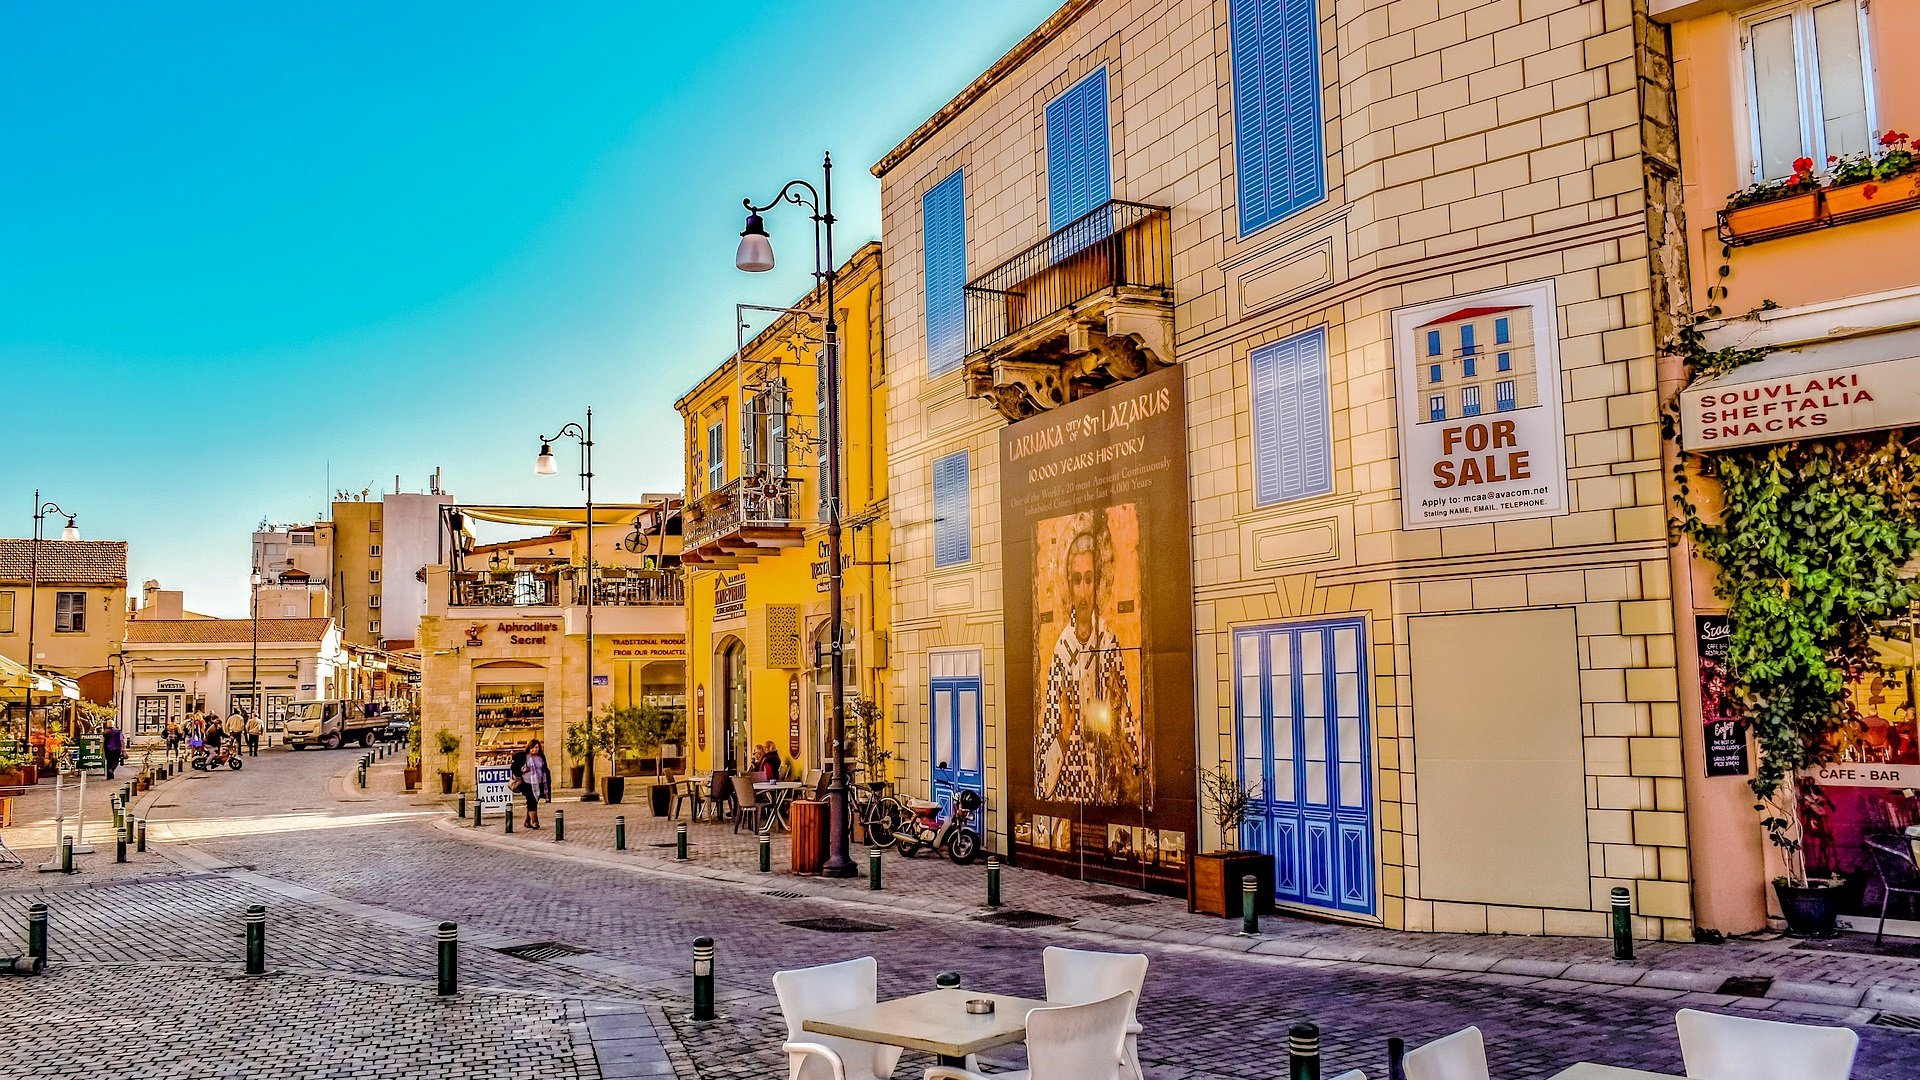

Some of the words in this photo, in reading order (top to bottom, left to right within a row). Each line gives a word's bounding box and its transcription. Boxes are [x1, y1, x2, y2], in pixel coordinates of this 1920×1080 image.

[1700, 374, 1858, 408] SOUVLAKI
[1701, 390, 1874, 424] SHEFTALIA
[1009, 425, 1064, 462] LARNAKA
[1102, 387, 1170, 432] LAZARUS
[1702, 413, 1828, 440] SNACKS
[1443, 419, 1517, 455] FOR
[1060, 451, 1094, 474] YEARS
[1096, 435, 1145, 464] HISTORY
[1094, 472, 1120, 486] Ancient
[1121, 456, 1171, 478] Continuously
[1433, 451, 1531, 489] SALE
[1131, 478, 1152, 489] Years
[1421, 498, 1447, 507] Apply
[1449, 496, 1461, 504] to:
[1463, 486, 1548, 503] mcaa@avacom.net
[1424, 509, 1447, 517] Stating
[497, 622, 558, 633] Aphrodite's
[510, 635, 546, 644] Secret
[480, 770, 510, 781] HOTEL
[1819, 769, 1856, 780] CAFE
[1870, 770, 1900, 781] BAR
[486, 785, 504, 793] CITY
